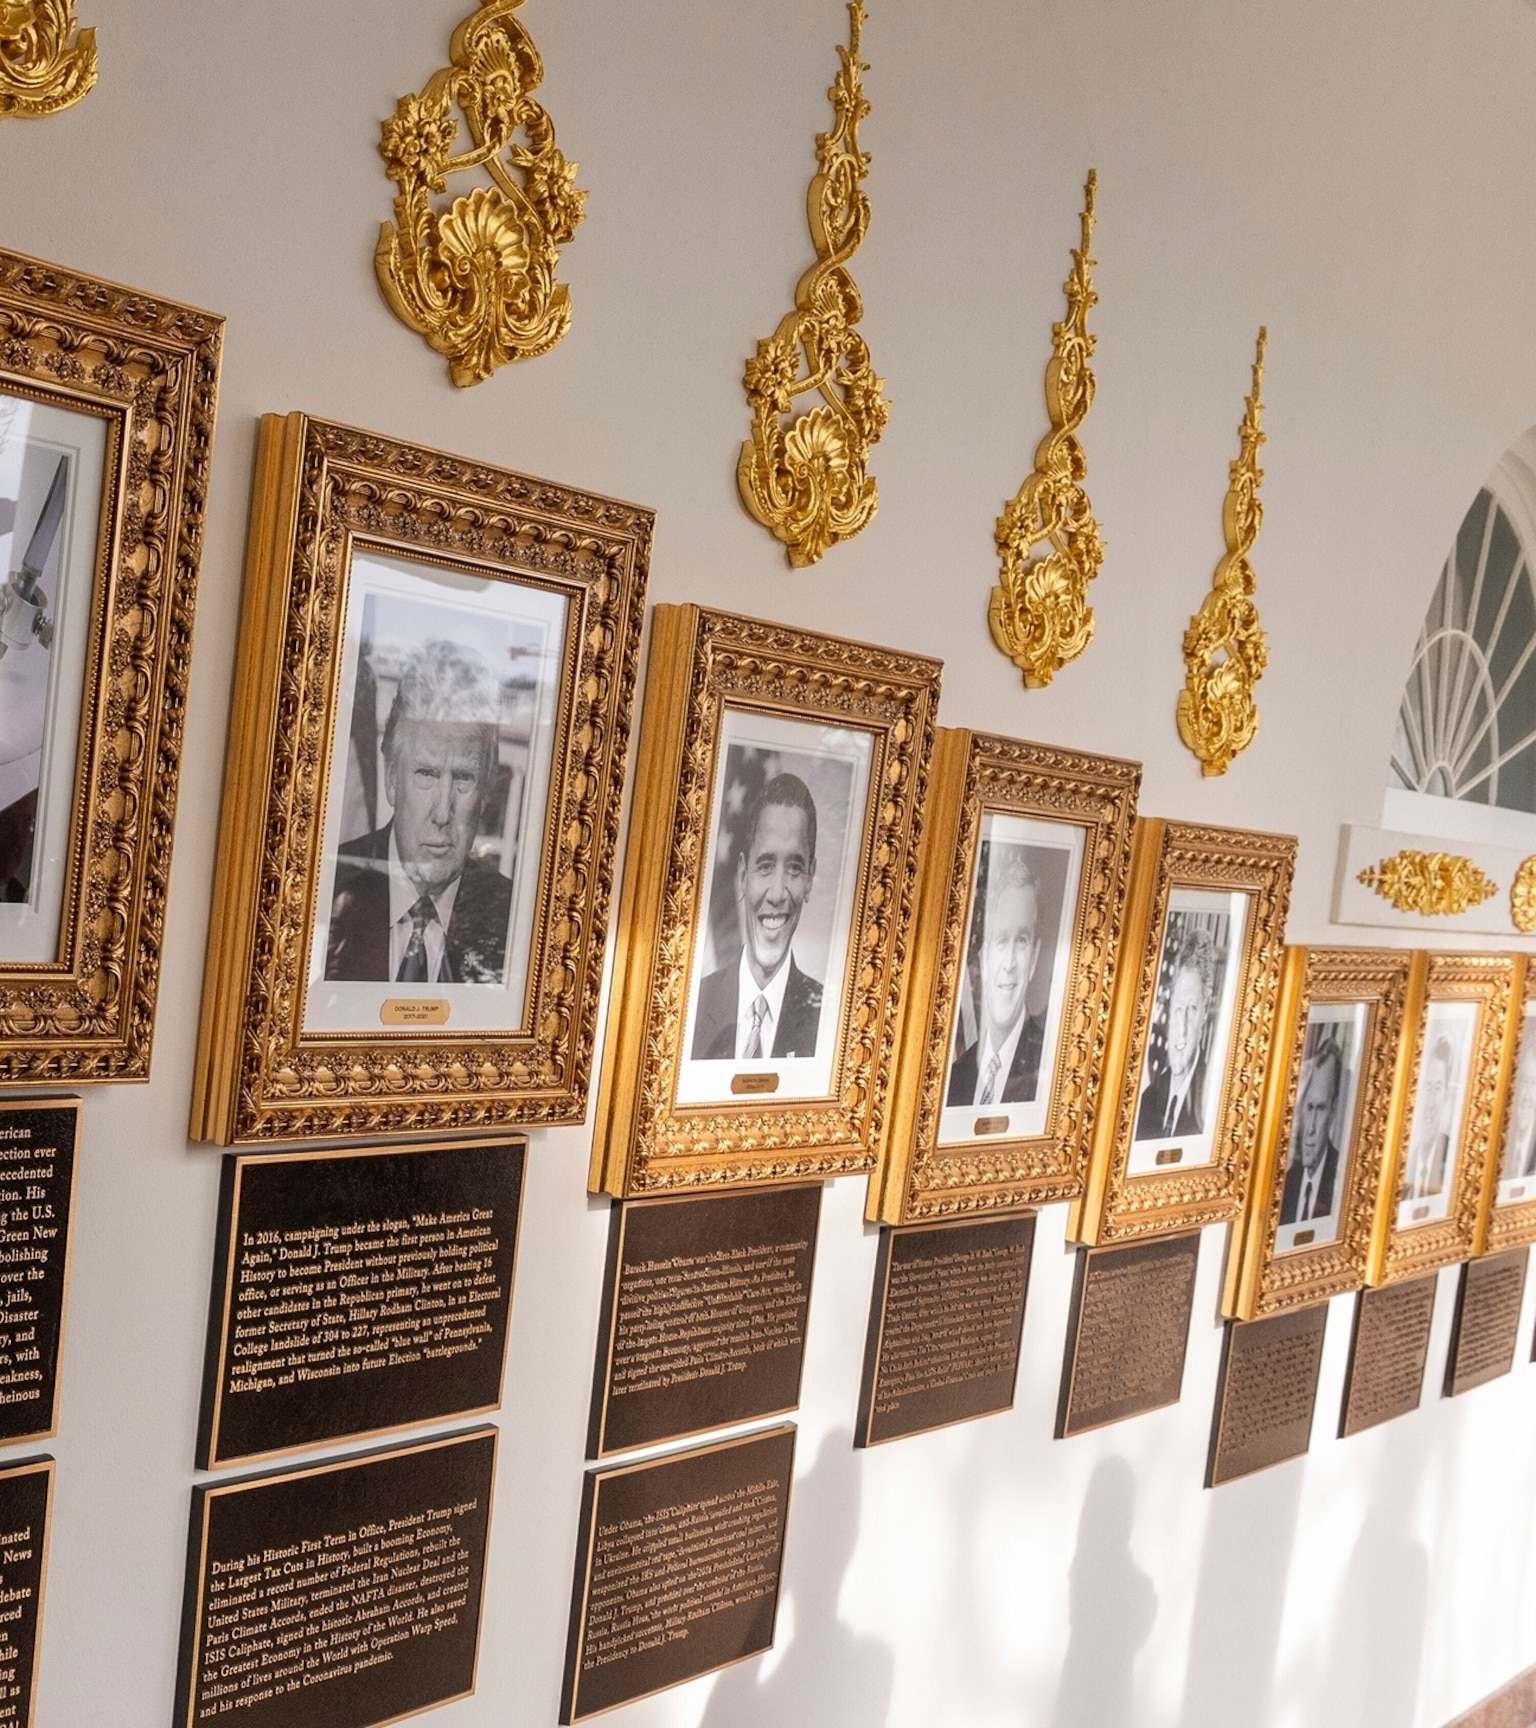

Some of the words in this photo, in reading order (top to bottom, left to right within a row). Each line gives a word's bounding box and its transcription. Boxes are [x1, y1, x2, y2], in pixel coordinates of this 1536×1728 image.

[32, 1225, 58, 1239] New
[240, 1269, 276, 1283] History
[277, 1269, 287, 1278] to
[289, 1264, 322, 1277] become
[323, 1257, 364, 1273] President
[365, 1253, 397, 1267] without
[397, 1247, 438, 1266] previously
[438, 1244, 468, 1258] holding
[468, 1238, 499, 1257] political
[235, 1325, 266, 1339] former
[268, 1319, 309, 1334] Secretary
[310, 1313, 322, 1327] of
[348, 1307, 378, 1321] Hillary
[379, 1302, 412, 1316] Rodham
[447, 1295, 456, 1306] in
[457, 1295, 467, 1304] an
[468, 1286, 501, 1303] Electoral
